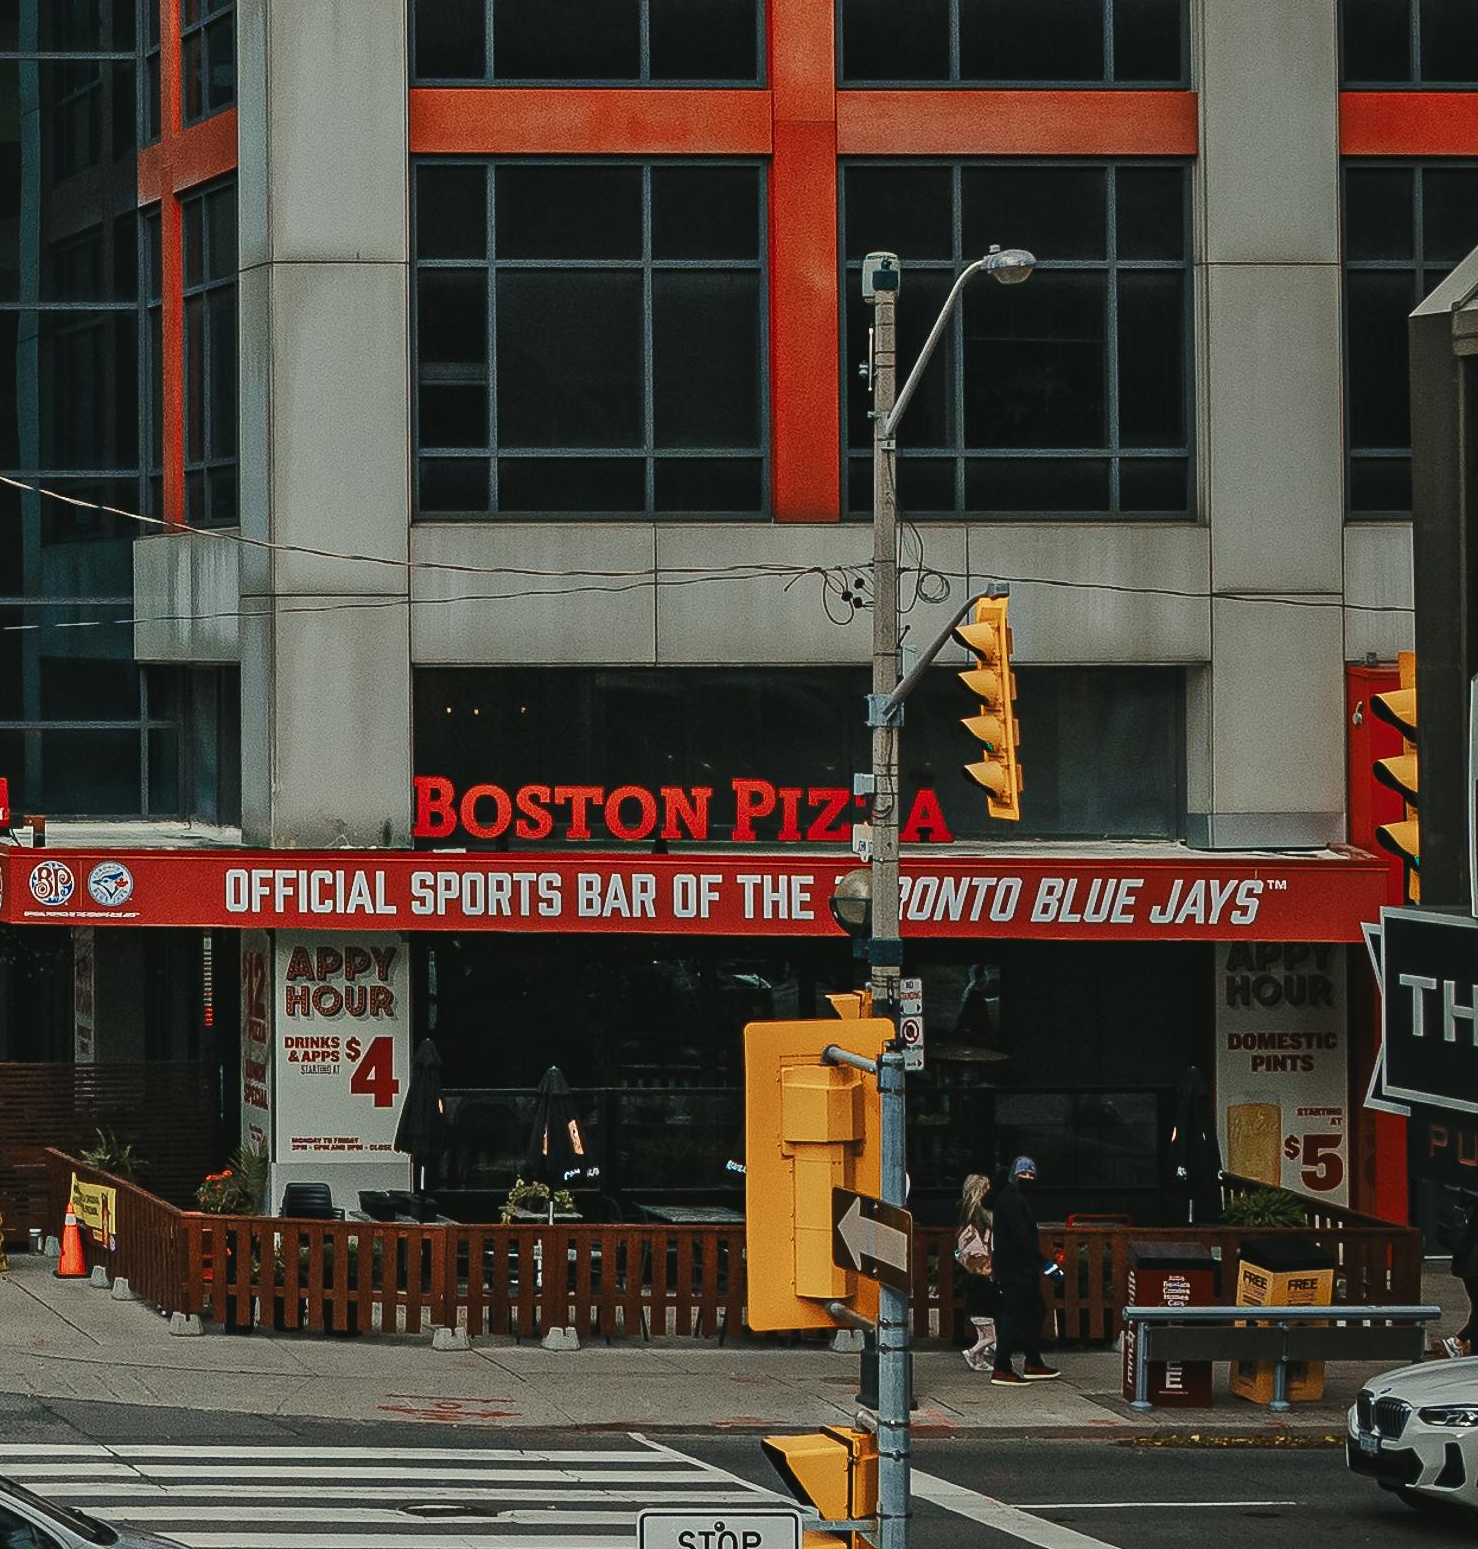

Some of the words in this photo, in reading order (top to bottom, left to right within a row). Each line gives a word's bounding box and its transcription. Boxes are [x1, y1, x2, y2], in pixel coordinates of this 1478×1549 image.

[414, 776, 713, 840] BOSTON
[731, 778, 953, 842] PIZA
[225, 869, 397, 915] OFFICIAL
[411, 871, 562, 917] SPORTS
[578, 873, 656, 918] BAR
[673, 874, 723, 918] OF
[737, 875, 814, 919] THE
[1030, 878, 1143, 923] BLUE
[286, 946, 397, 981] APPY
[1227, 975, 1333, 1007] HOUR
[286, 985, 396, 1017] HOUR
[284, 1037, 340, 1049] DRINKS
[1228, 1033, 1338, 1050] DOMESTIC
[288, 1051, 299, 1062] &
[301, 1051, 340, 1062] APPS
[1251, 1054, 1314, 1072] PINTS
[1297, 1107, 1342, 1116] STARTING
[1243, 1270, 1267, 1289] FREE
[1288, 1278, 1318, 1290] FREE
